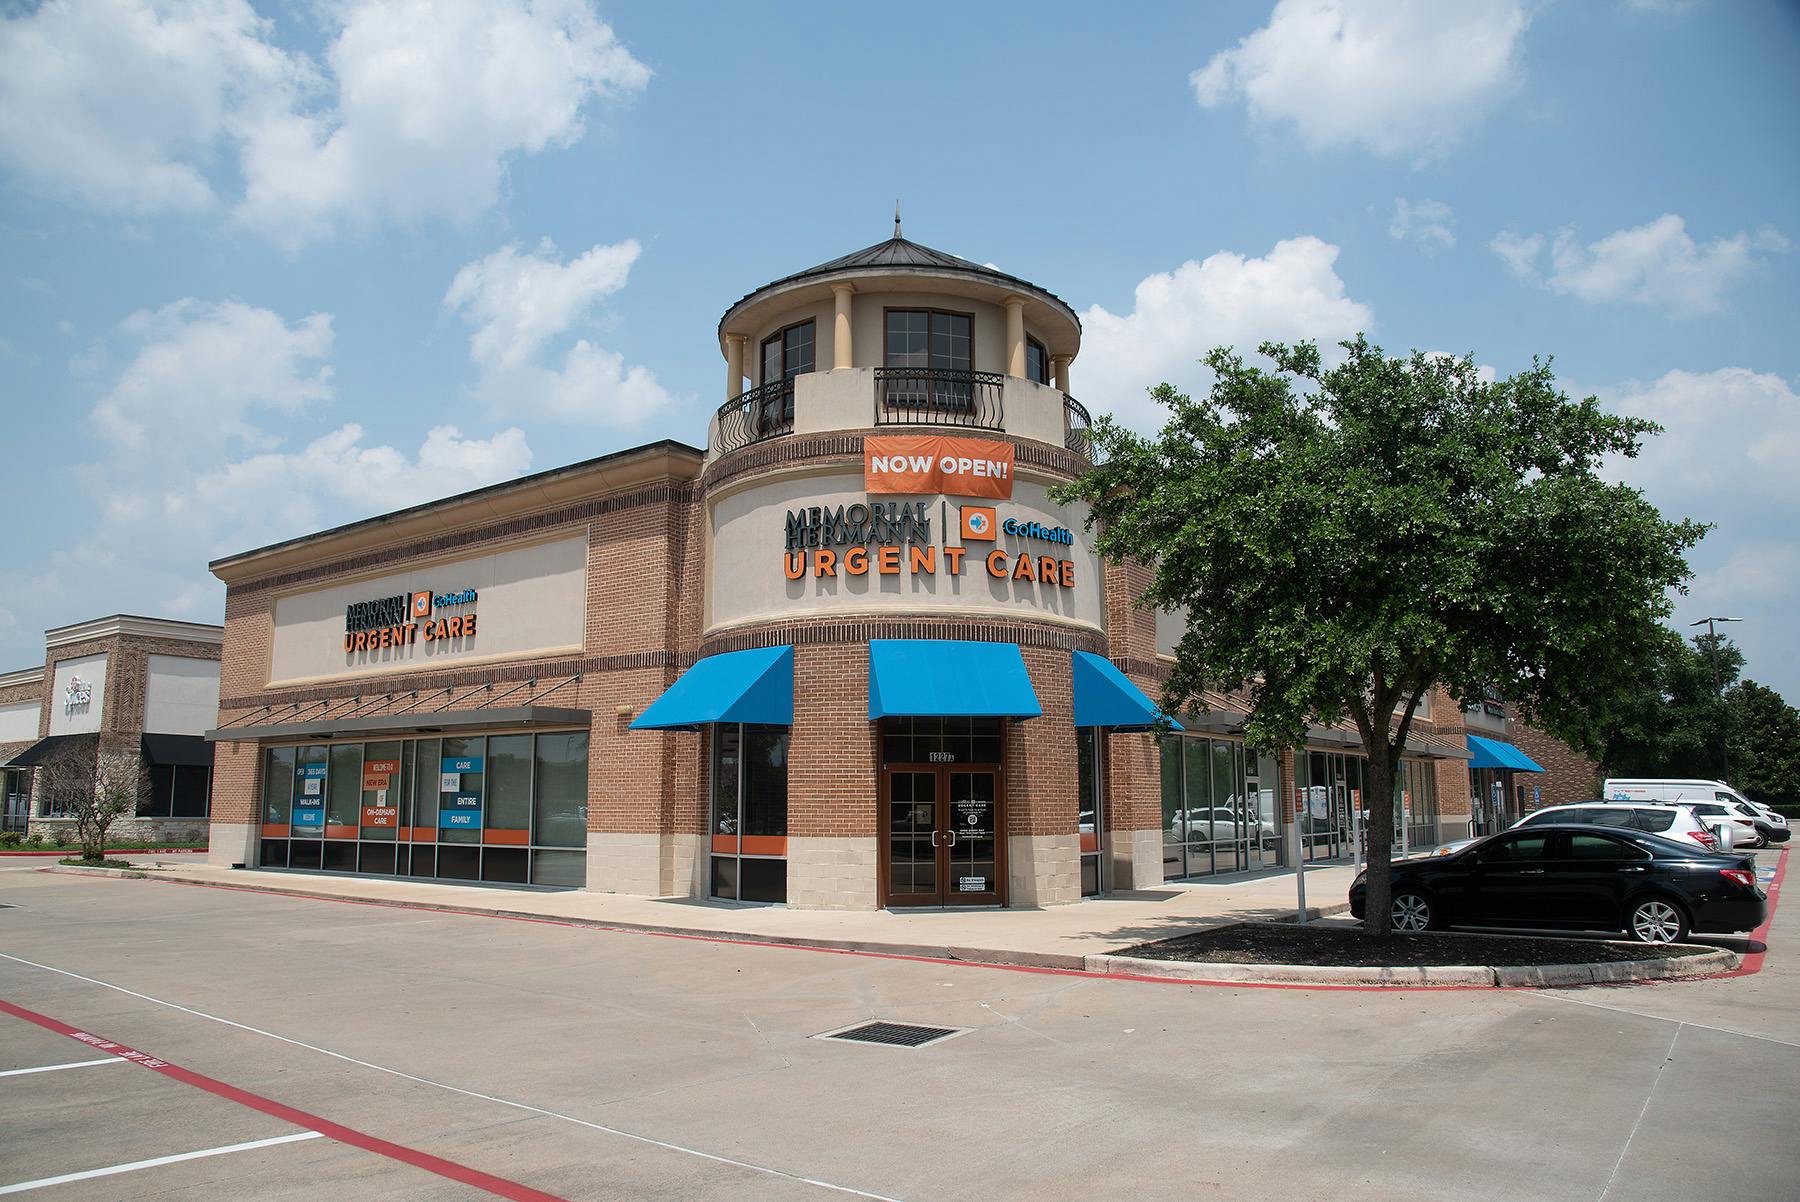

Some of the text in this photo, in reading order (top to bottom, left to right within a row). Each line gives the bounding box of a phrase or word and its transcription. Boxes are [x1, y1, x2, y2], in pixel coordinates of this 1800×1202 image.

[871, 455, 1008, 479] NOW OPEN!
[784, 501, 930, 531] MEMORIAL
[784, 518, 930, 550] HERMANN
[1003, 517, 1074, 546] GoHealth
[784, 546, 1075, 587] URGENT CARE
[346, 595, 404, 619] MEMORIAL
[433, 589, 477, 608] GoHealth
[345, 606, 405, 631] HERMANN
[344, 614, 477, 653] URGENT CARE
[457, 797, 477, 806] ENTIRE
[451, 815, 471, 824] FAMILY
